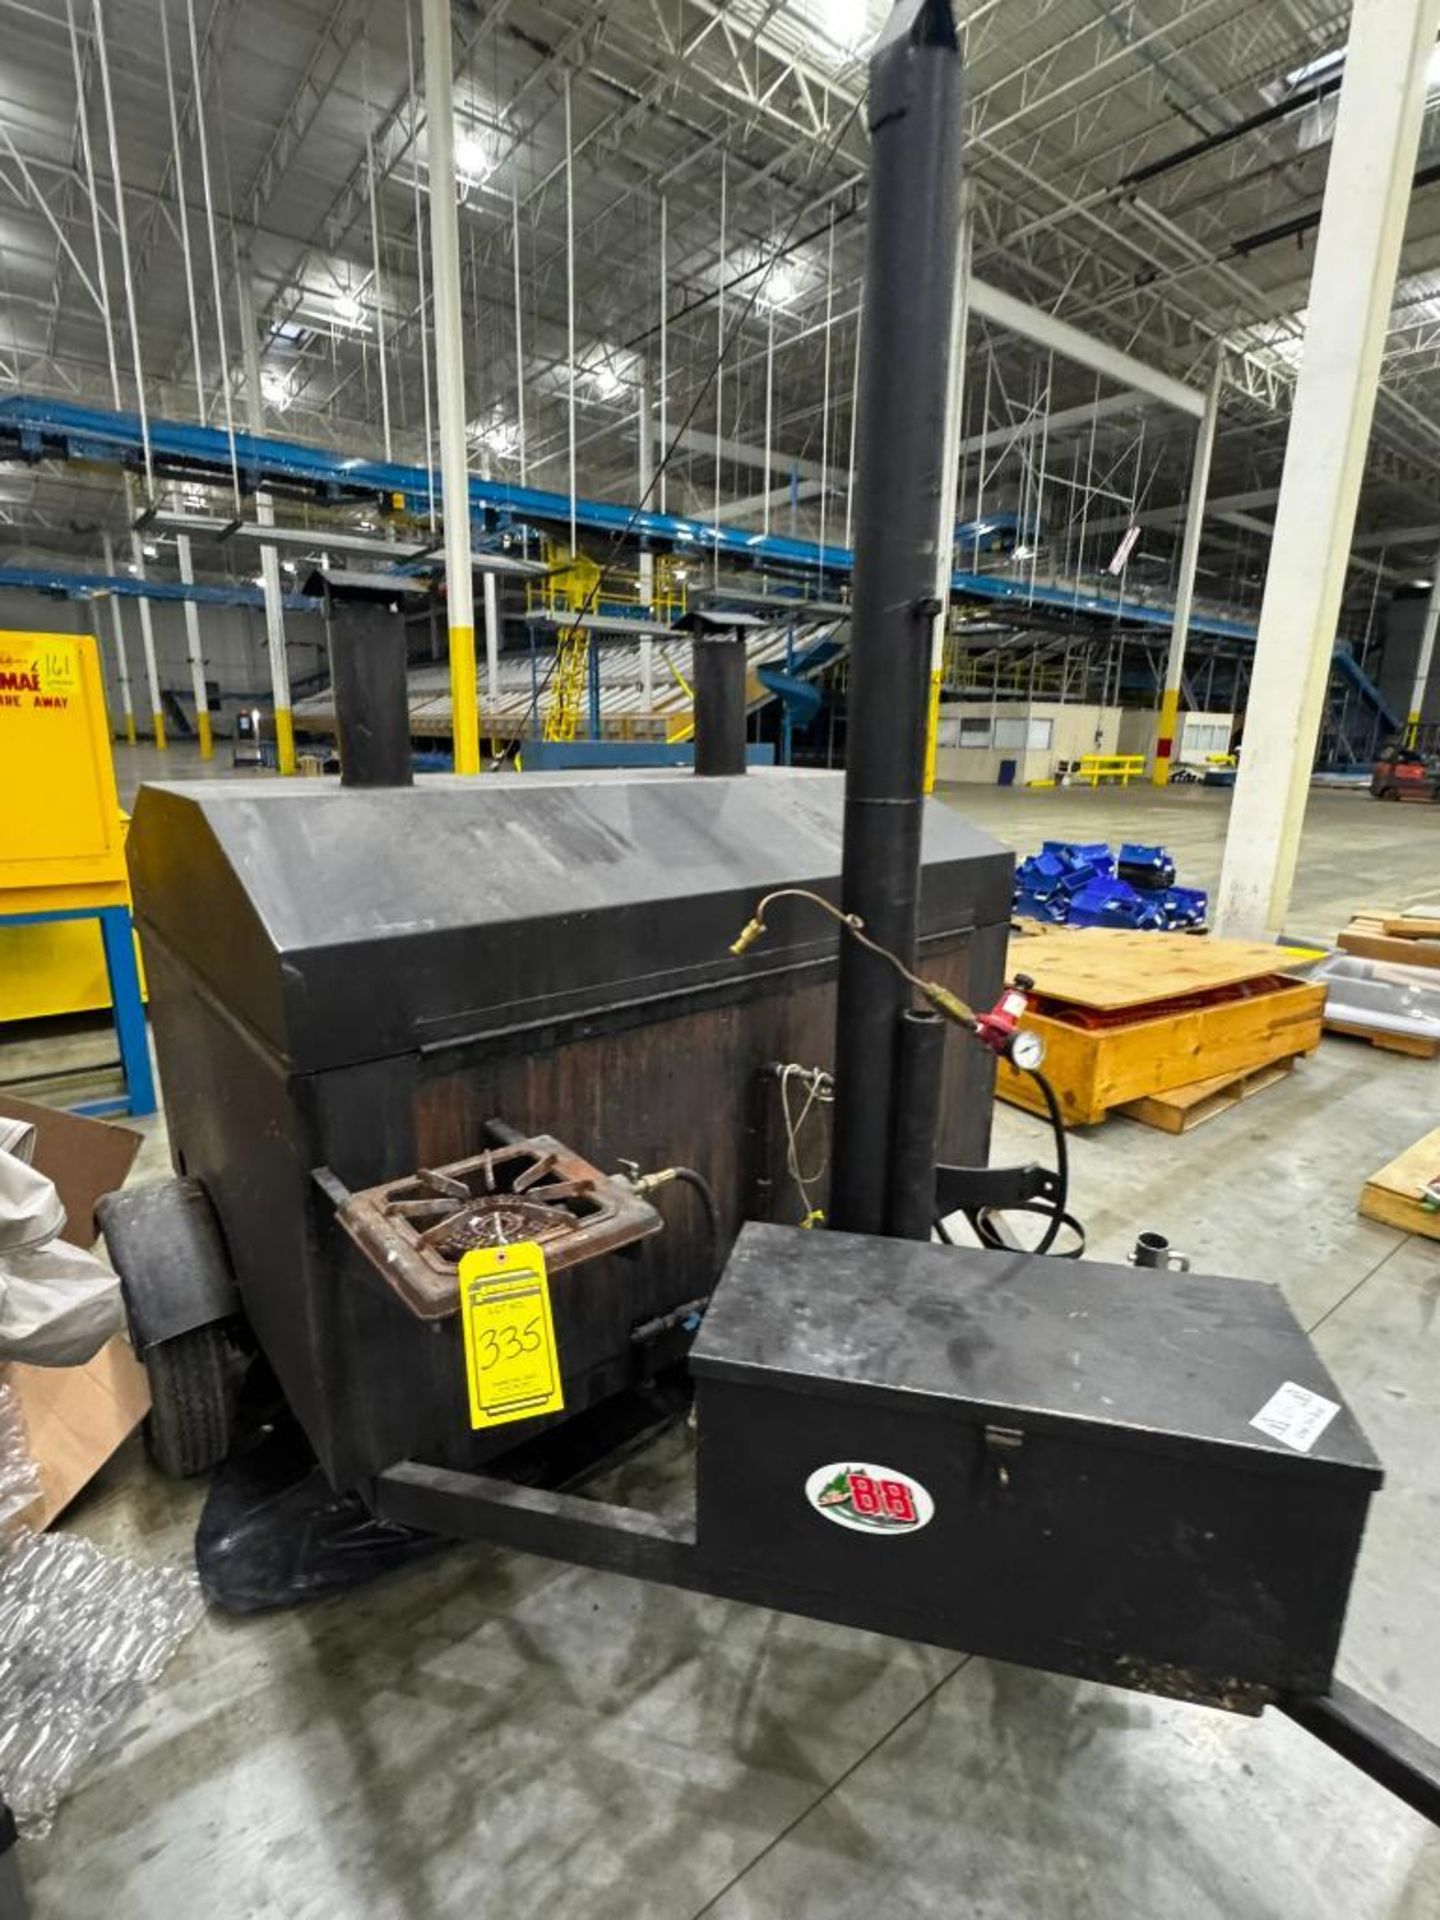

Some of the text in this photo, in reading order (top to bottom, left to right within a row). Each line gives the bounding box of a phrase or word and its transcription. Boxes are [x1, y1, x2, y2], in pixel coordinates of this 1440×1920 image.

[46, 653, 70, 676] 161
[34, 695, 69, 709] AWAY
[478, 1317, 541, 1370] 335
[847, 1474, 917, 1523] 88
